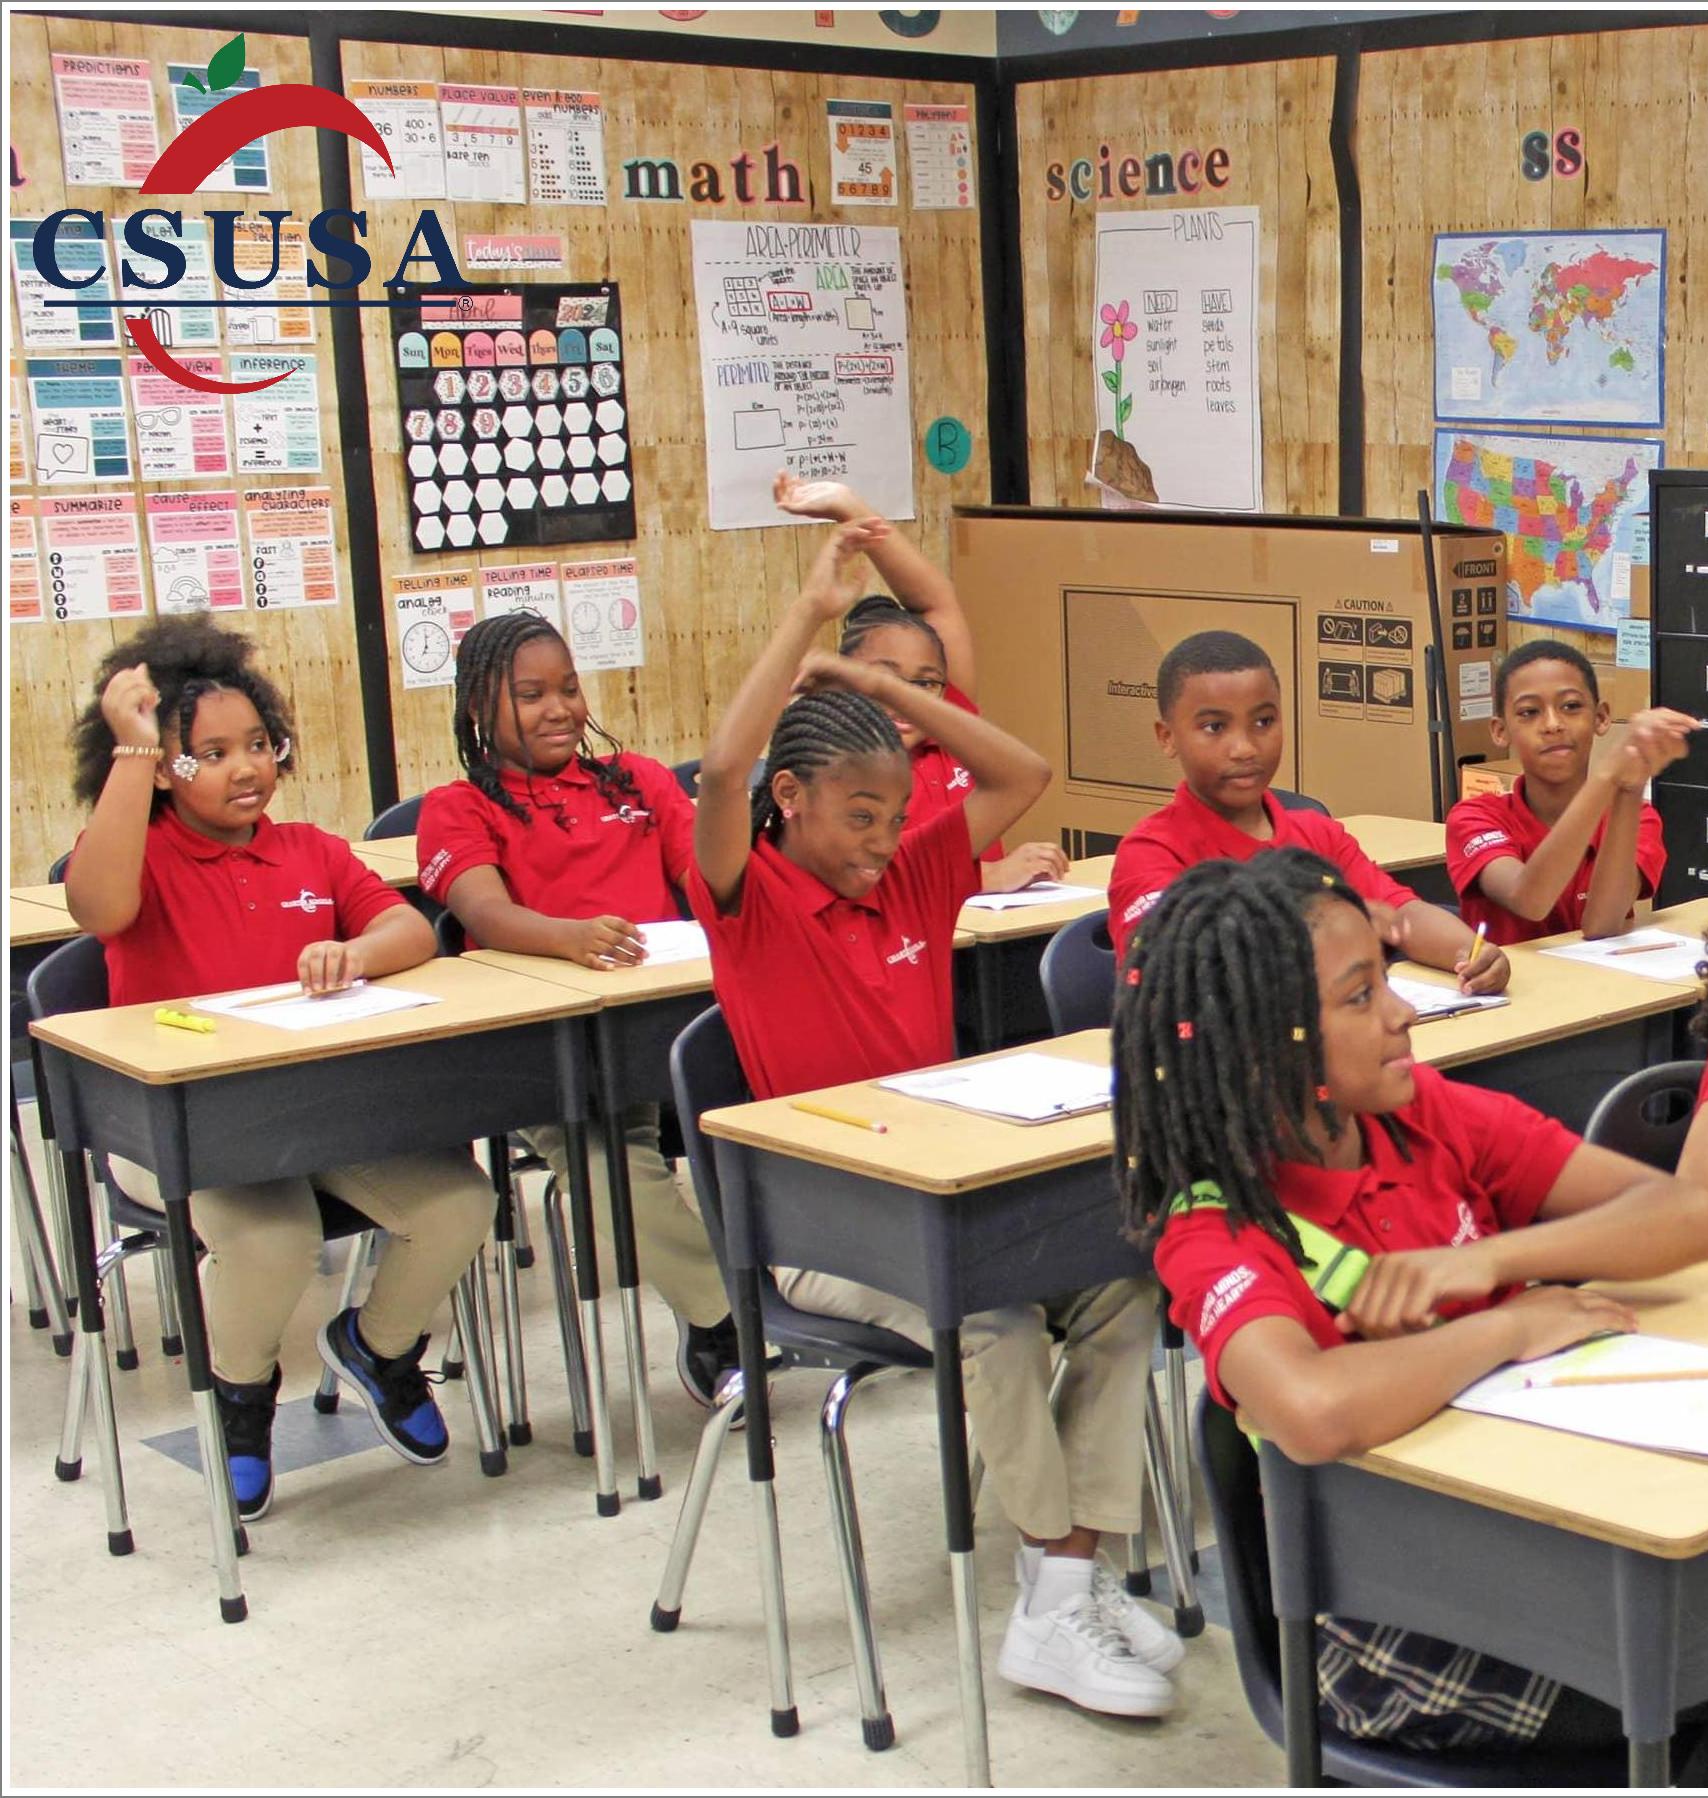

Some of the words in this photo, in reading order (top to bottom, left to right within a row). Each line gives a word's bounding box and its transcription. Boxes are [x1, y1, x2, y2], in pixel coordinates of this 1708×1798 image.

[375, 122, 393, 136] 36
[404, 119, 425, 130] 400
[623, 146, 806, 204] math
[858, 162, 872, 174] 45
[1046, 144, 1231, 201] science
[1173, 212, 1224, 241] PLANTS
[816, 265, 849, 291] AREA
[1147, 292, 1172, 312] NEED
[1203, 292, 1228, 312] HAVE
[1147, 318, 1173, 332] water
[1202, 318, 1224, 333] seeds
[402, 346, 426, 360] Sun
[1146, 337, 1178, 355] sunlight
[1203, 338, 1234, 357] petals
[1148, 355, 1163, 373] soil
[1205, 358, 1230, 373] stem
[476, 374, 490, 397] 2
[508, 373, 523, 396] 3
[569, 371, 581, 392] 5
[1206, 377, 1231, 393] roots
[1206, 398, 1236, 413] leaves
[412, 417, 426, 437] 7
[443, 412, 458, 435] 8
[481, 411, 495, 434] 9
[1464, 562, 1495, 575] FRONT
[1343, 599, 1385, 612] CAUTION
[1108, 680, 1158, 699] Interactive
